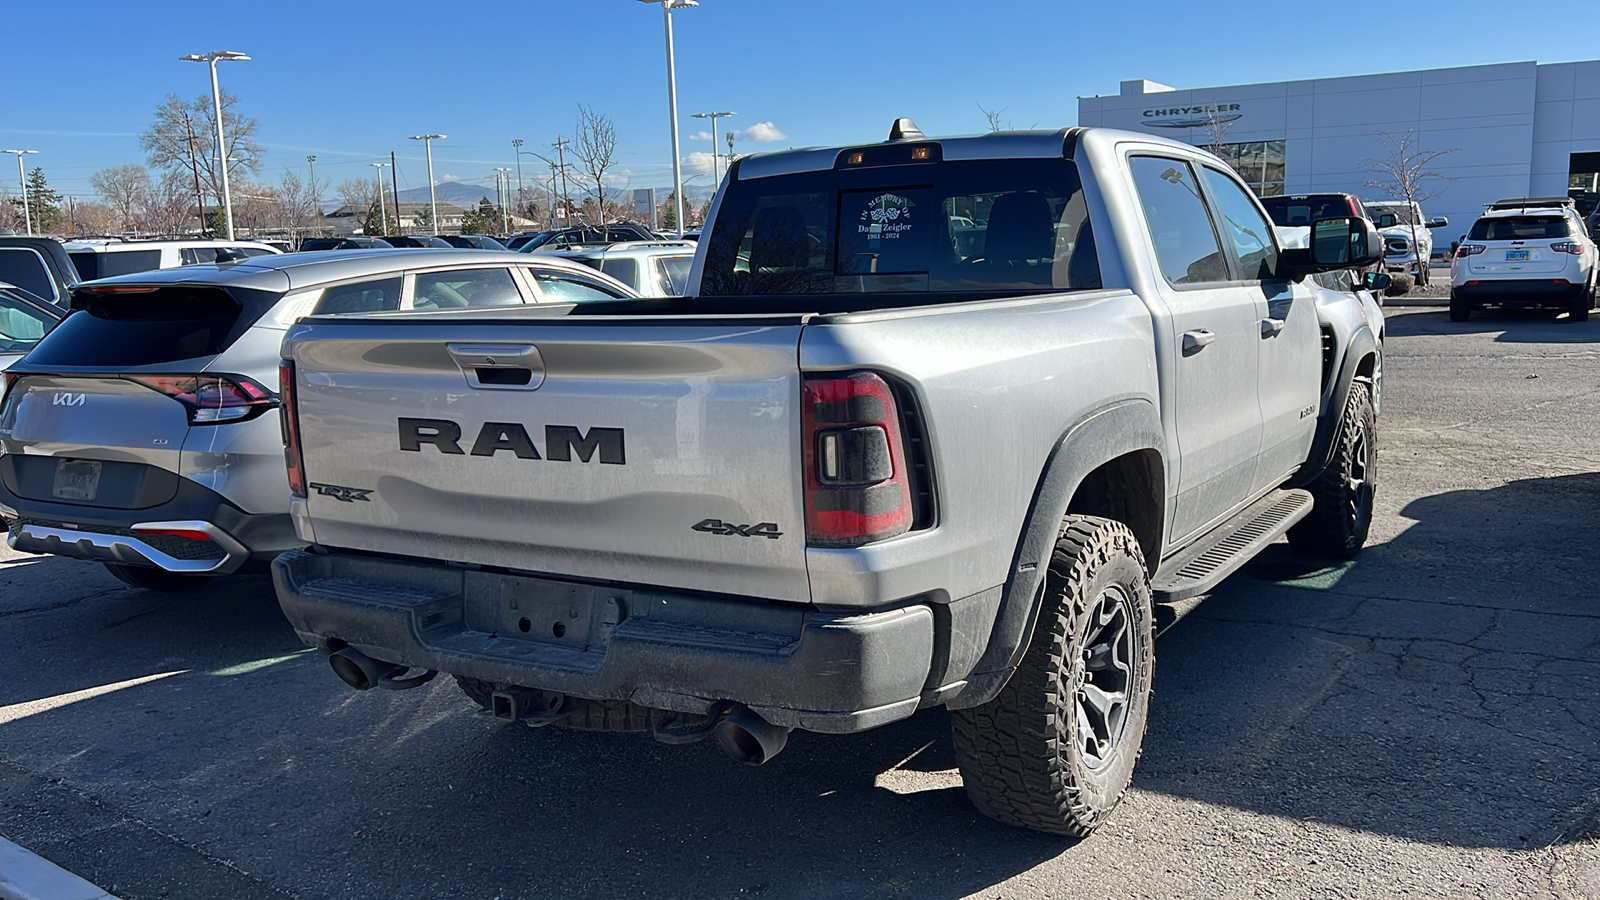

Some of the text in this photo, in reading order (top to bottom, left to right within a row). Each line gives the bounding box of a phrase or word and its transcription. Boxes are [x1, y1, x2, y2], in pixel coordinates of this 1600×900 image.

[1142, 103, 1241, 117] CHRYSLER
[861, 194, 910, 220] IN MEMORY OF
[883, 222, 912, 232] Zeigler
[398, 417, 626, 465] RAM
[309, 482, 374, 502] TRX
[690, 518, 784, 540] 4x4
